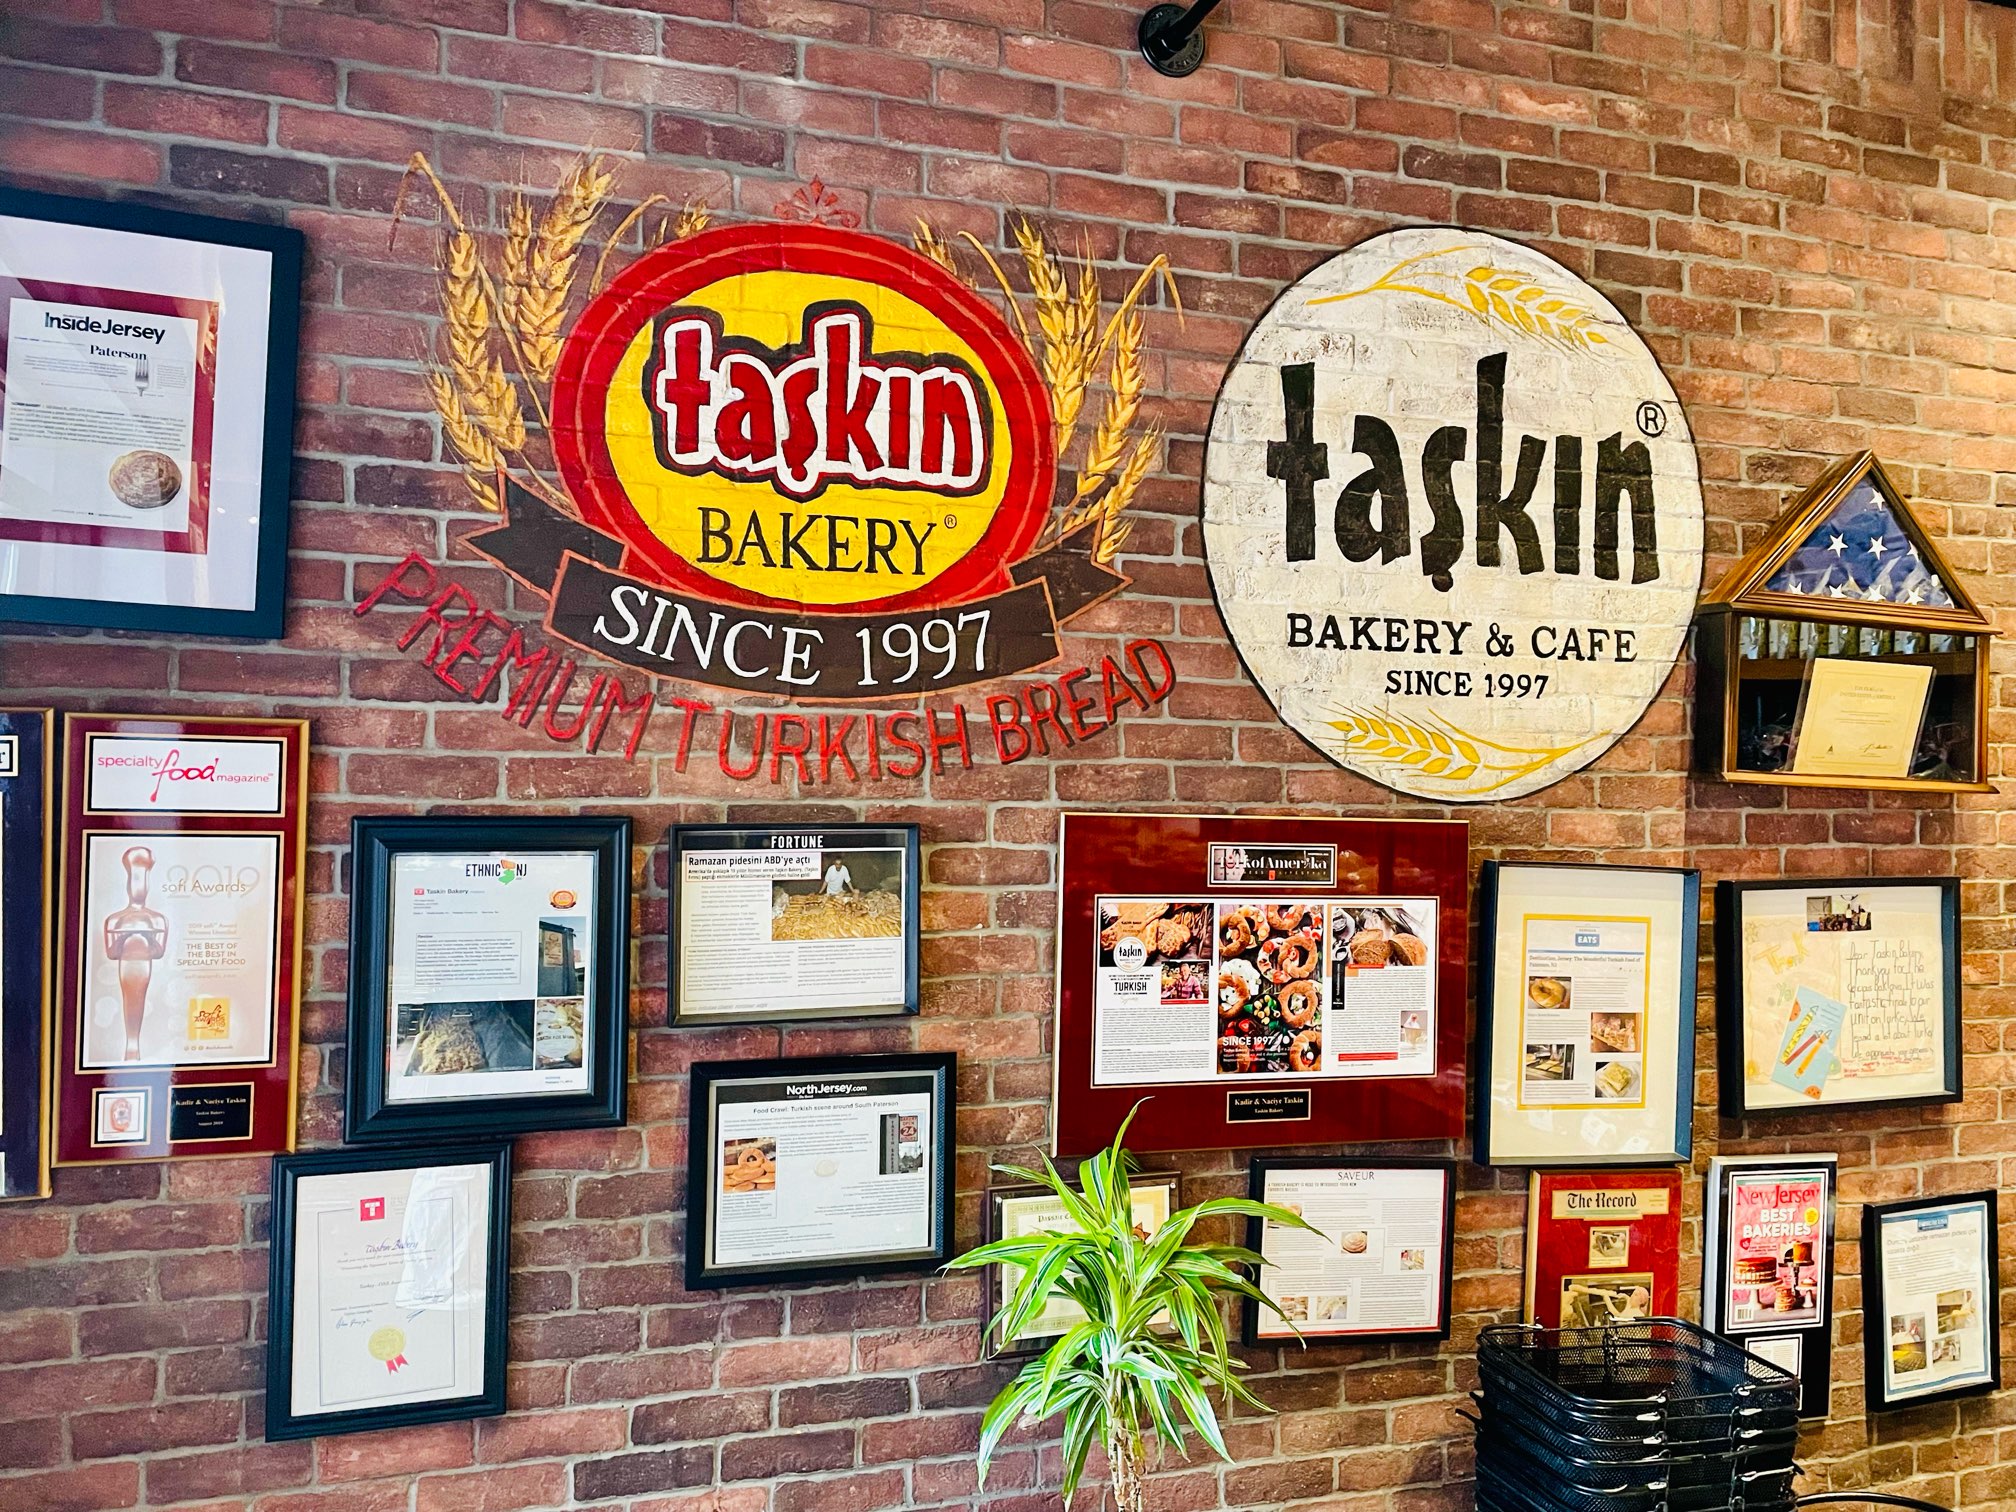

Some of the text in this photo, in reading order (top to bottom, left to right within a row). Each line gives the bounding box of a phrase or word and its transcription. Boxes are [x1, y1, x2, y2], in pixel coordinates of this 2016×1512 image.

[90, 345, 147, 361] Paterson
[1266, 351, 1661, 593] taşkın
[697, 506, 937, 576] BAKERY
[592, 585, 992, 685] SINCE 1997
[1286, 612, 1639, 664] BAKERY & CAFE
[353, 552, 1178, 785] PREMIUM TURKISH BREAD
[1385, 668, 1550, 700] SINCE 1997
[98, 755, 163, 769] specialty
[150, 748, 219, 803] food
[771, 835, 824, 849] FORTUNE
[689, 855, 810, 867] Ramazan pidesini ABD'ye açtı
[465, 863, 527, 877] ETHNIC NJ
[162, 879, 246, 893] sofi Awards
[166, 864, 261, 899] 2019
[226, 942, 238, 950] OF
[1577, 935, 1597, 944] EATS
[1114, 982, 1147, 992] TURKISH
[1222, 1036, 1274, 1046] SINCE 1997
[786, 1083, 868, 1096] NorthJersey.com
[753, 1107, 770, 1115] Food
[791, 1104, 812, 1113] Turkish
[1337, 1171, 1375, 1181] SAVEUR
[1567, 1192, 1637, 1208] The Record
[1760, 1208, 1796, 1223] BEST
[1743, 1222, 1812, 1239] BAKERIES
